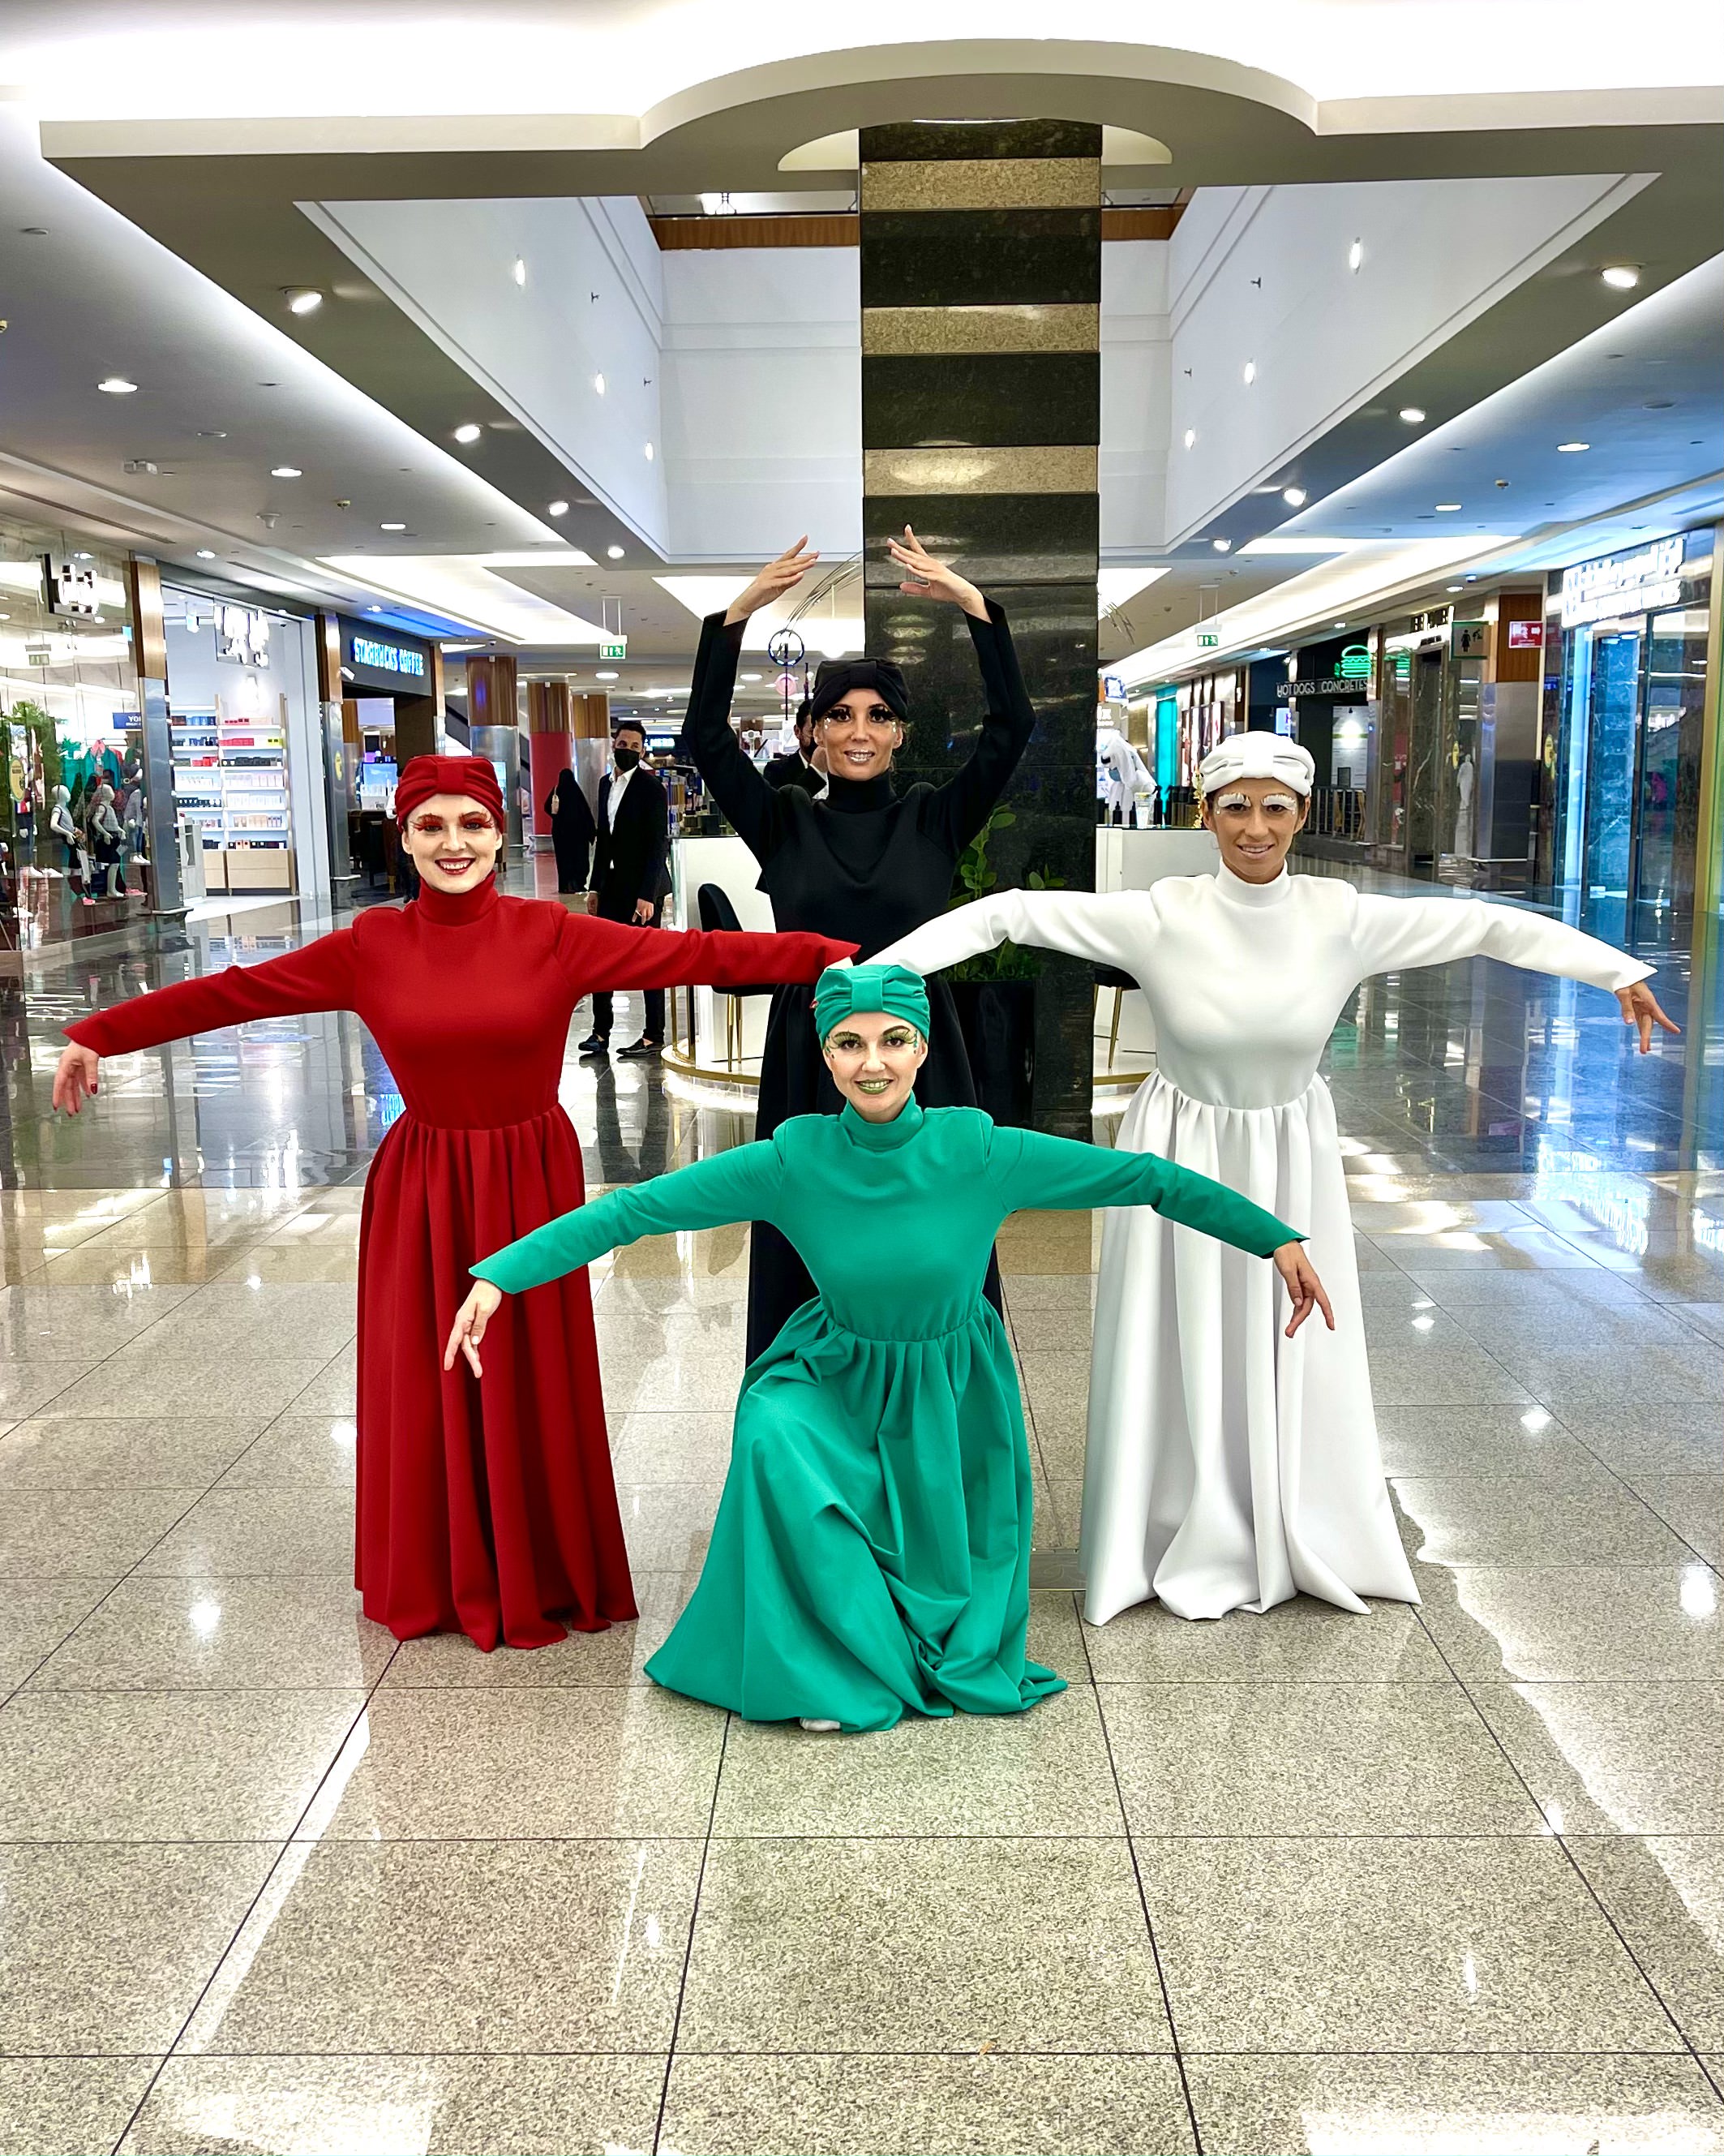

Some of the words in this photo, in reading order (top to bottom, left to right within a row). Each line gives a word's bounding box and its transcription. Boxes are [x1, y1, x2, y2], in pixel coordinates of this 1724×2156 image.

[354, 637, 397, 671] STARBUCKS
[399, 649, 424, 676] COFFEE
[1276, 684, 1293, 698] HOT
[1293, 682, 1314, 695] DOGS
[1321, 679, 1367, 693] CONCRETES
